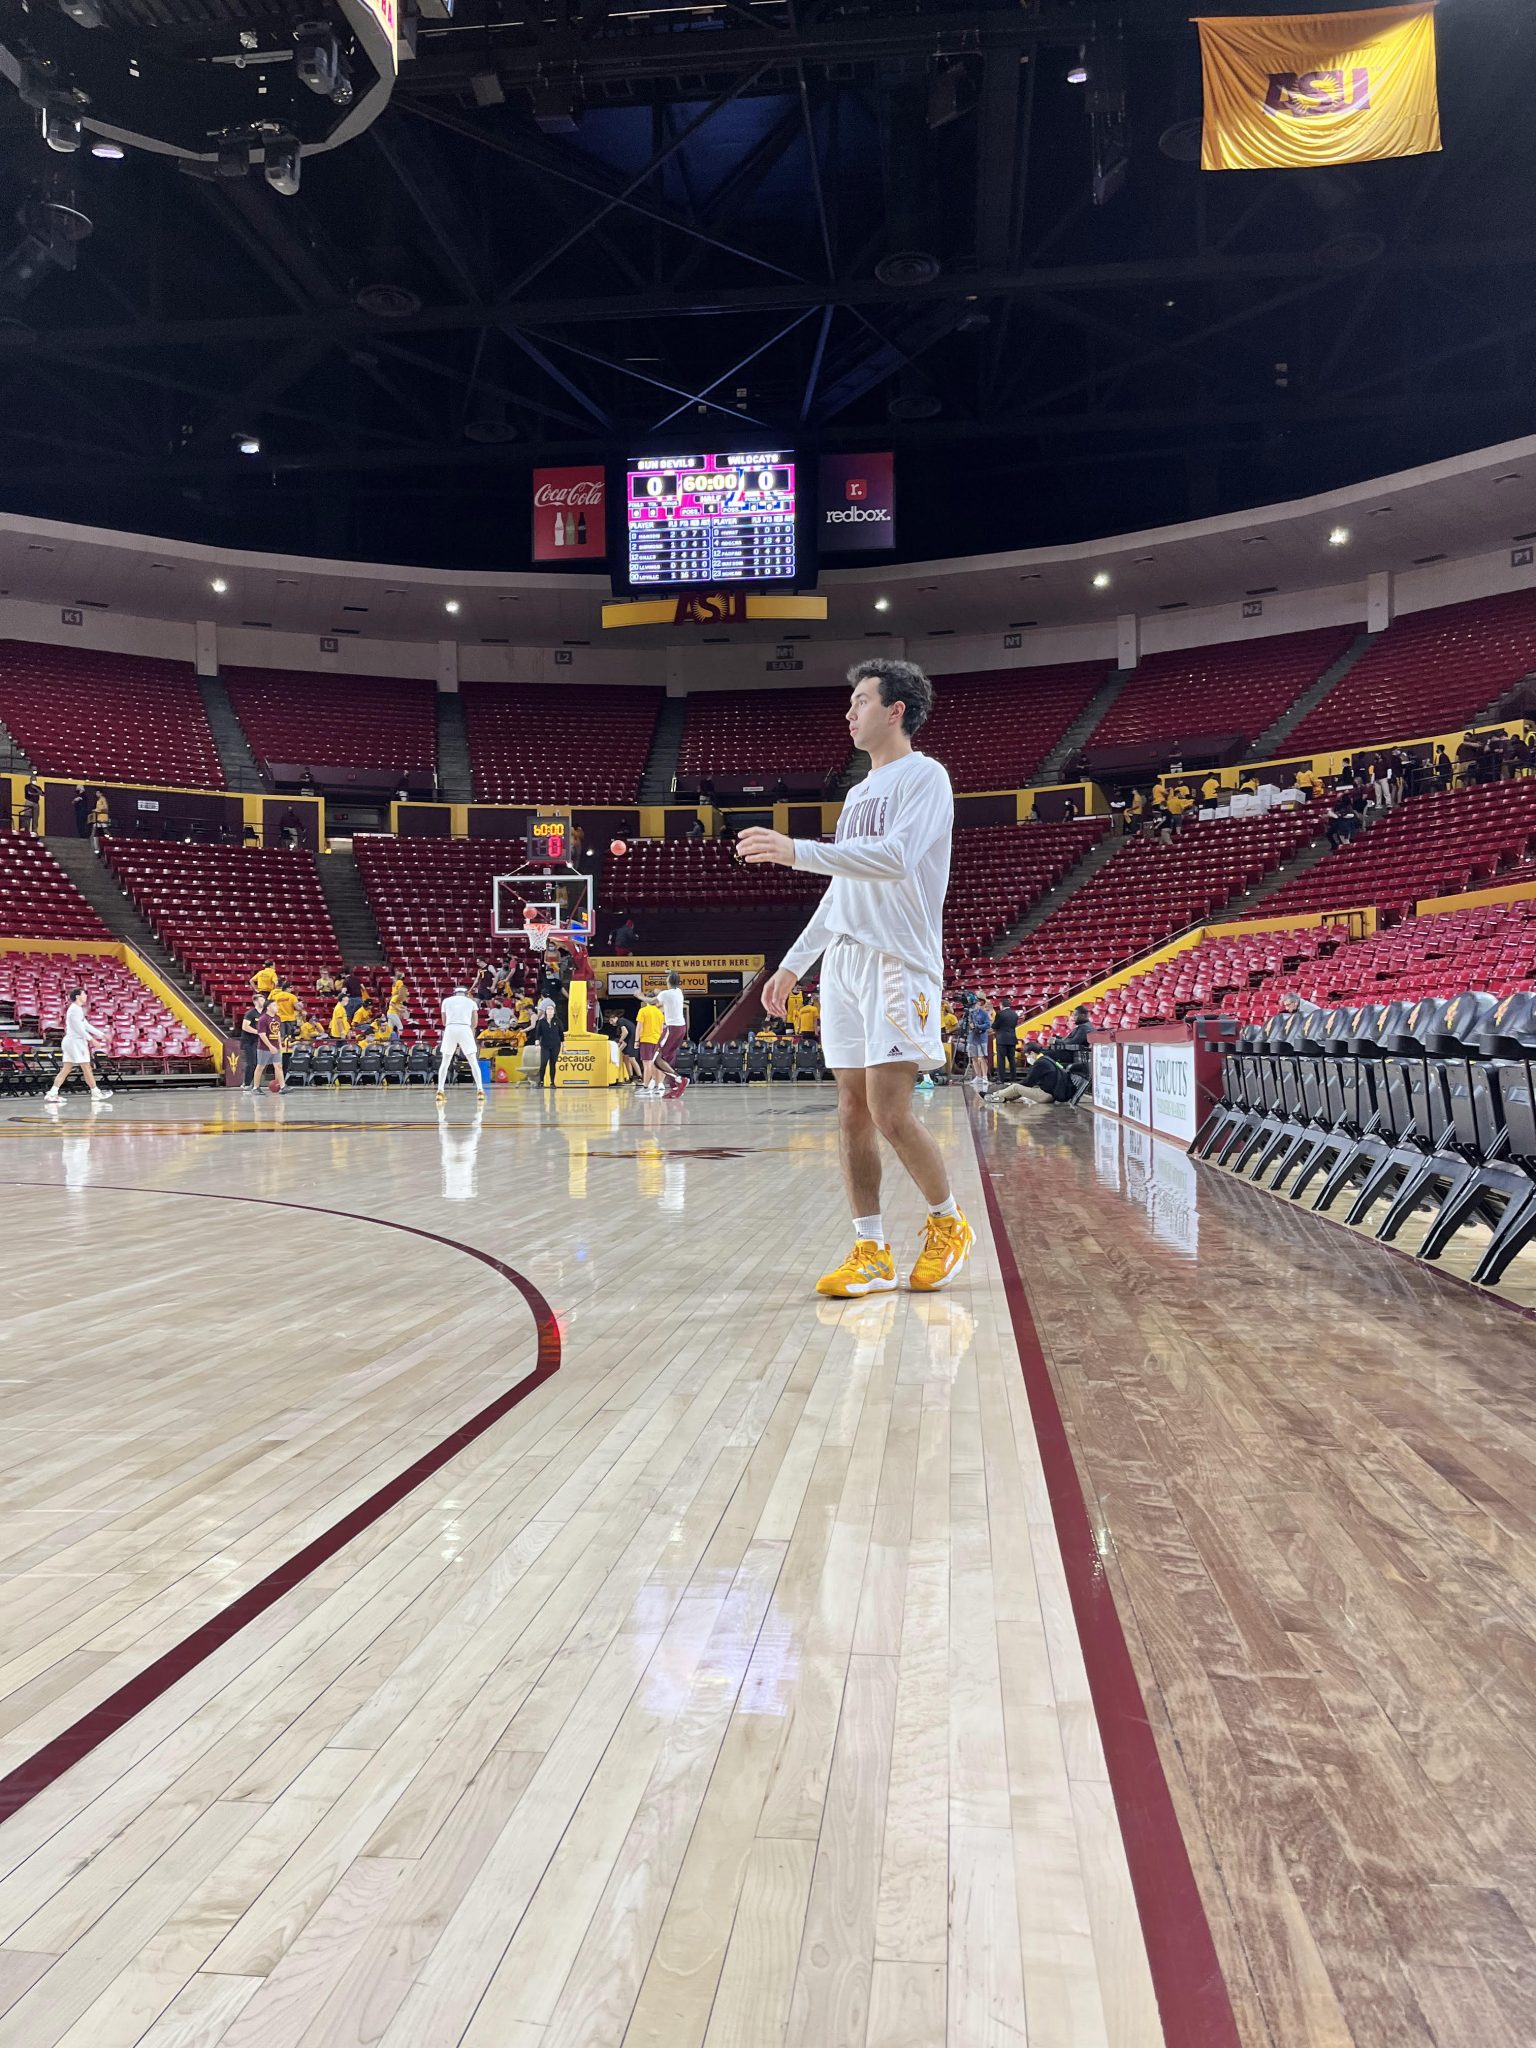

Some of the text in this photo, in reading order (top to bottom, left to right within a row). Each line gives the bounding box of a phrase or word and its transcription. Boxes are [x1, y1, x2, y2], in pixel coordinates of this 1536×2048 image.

[1263, 67, 1371, 118] ASU
[637, 458, 695, 470] SUN DEVILS
[727, 454, 779, 465] WILDCATS
[646, 476, 663, 496] 0
[683, 474, 738, 492] 60:00
[758, 471, 774, 491] 0
[534, 481, 605, 507] Coca-Cola
[630, 521, 655, 529] PLAYER
[670, 551, 676, 559] 2
[754, 568, 759, 576] 1
[674, 591, 748, 626] ASU
[771, 661, 798, 670] EAST
[533, 823, 564, 836] 60:00
[601, 960, 634, 968] ABANDON
[683, 959, 700, 967] WHO
[702, 959, 727, 967] ENTER
[611, 980, 639, 989] TOCA
[558, 1063, 568, 1072] of
[1155, 1059, 1188, 1097] SPROUTS
